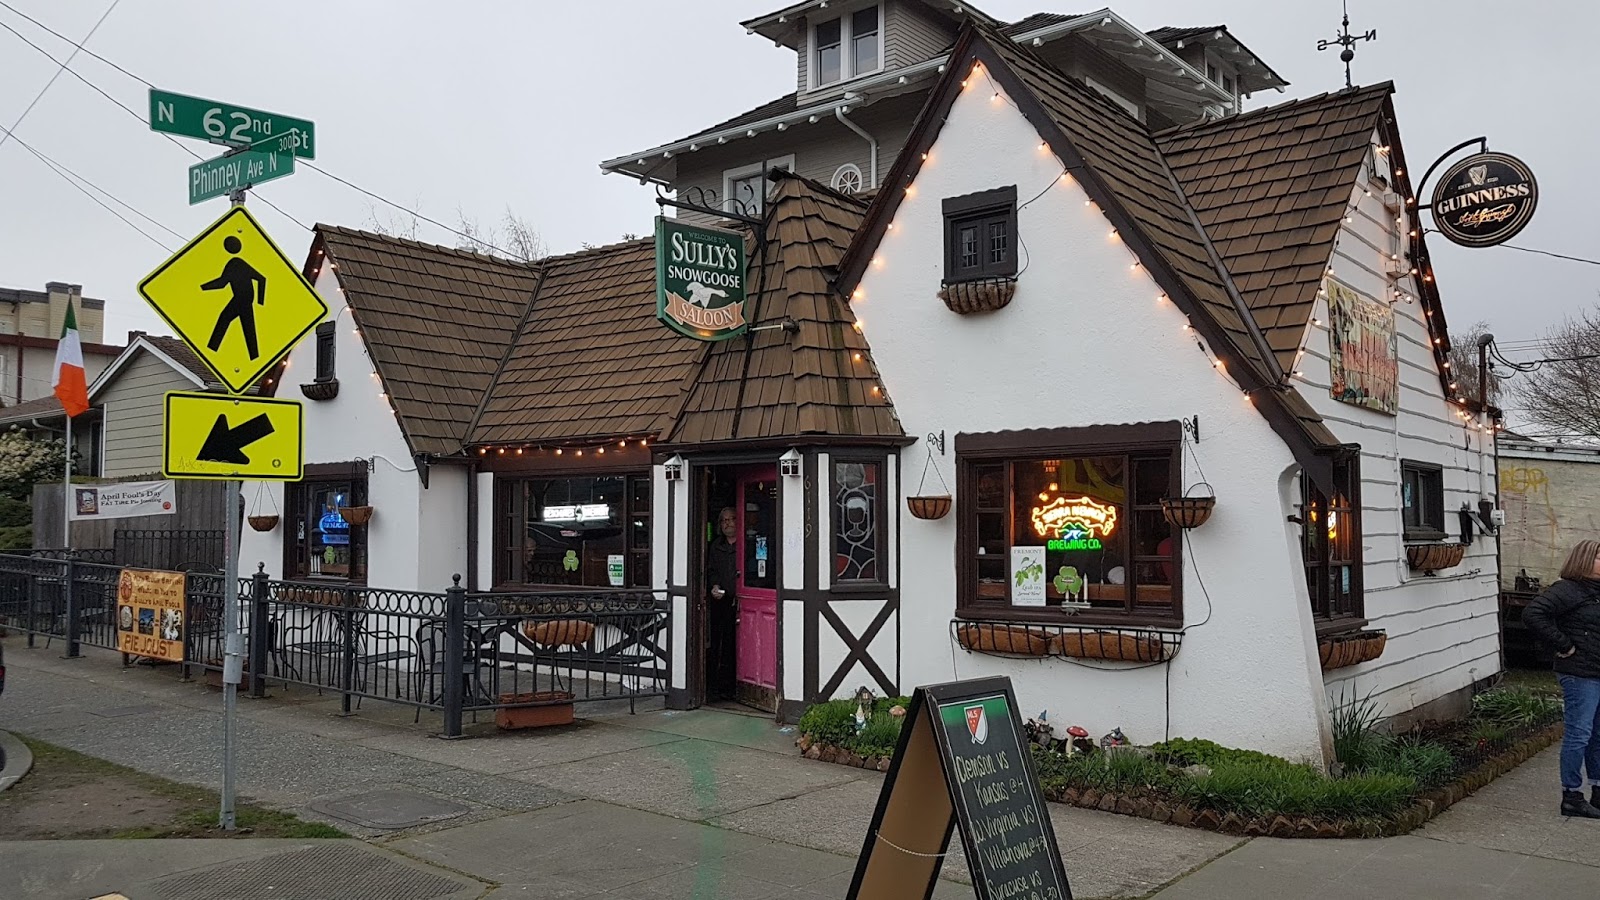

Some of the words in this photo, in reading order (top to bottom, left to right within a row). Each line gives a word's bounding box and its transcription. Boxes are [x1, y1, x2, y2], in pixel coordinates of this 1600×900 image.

[158, 101, 174, 124] N
[203, 108, 272, 143] 62nd
[278, 138, 292, 152] 300
[193, 160, 241, 198] Phinney
[247, 159, 263, 181] Ave
[269, 152, 277, 173] N
[1437, 182, 1530, 215] GUINNESS
[688, 231, 717, 244] WELCOME
[671, 232, 738, 271] SULLY'S
[668, 265, 741, 289] SNOWGOOSE
[680, 302, 734, 327] SALOON
[101, 493, 120, 502] April
[1048, 539, 1087, 550] BREWING
[124, 634, 139, 651] PIE
[140, 638, 174, 657] JOUST
[956, 755, 997, 784] Clemson
[974, 781, 1010, 809] Kansas
